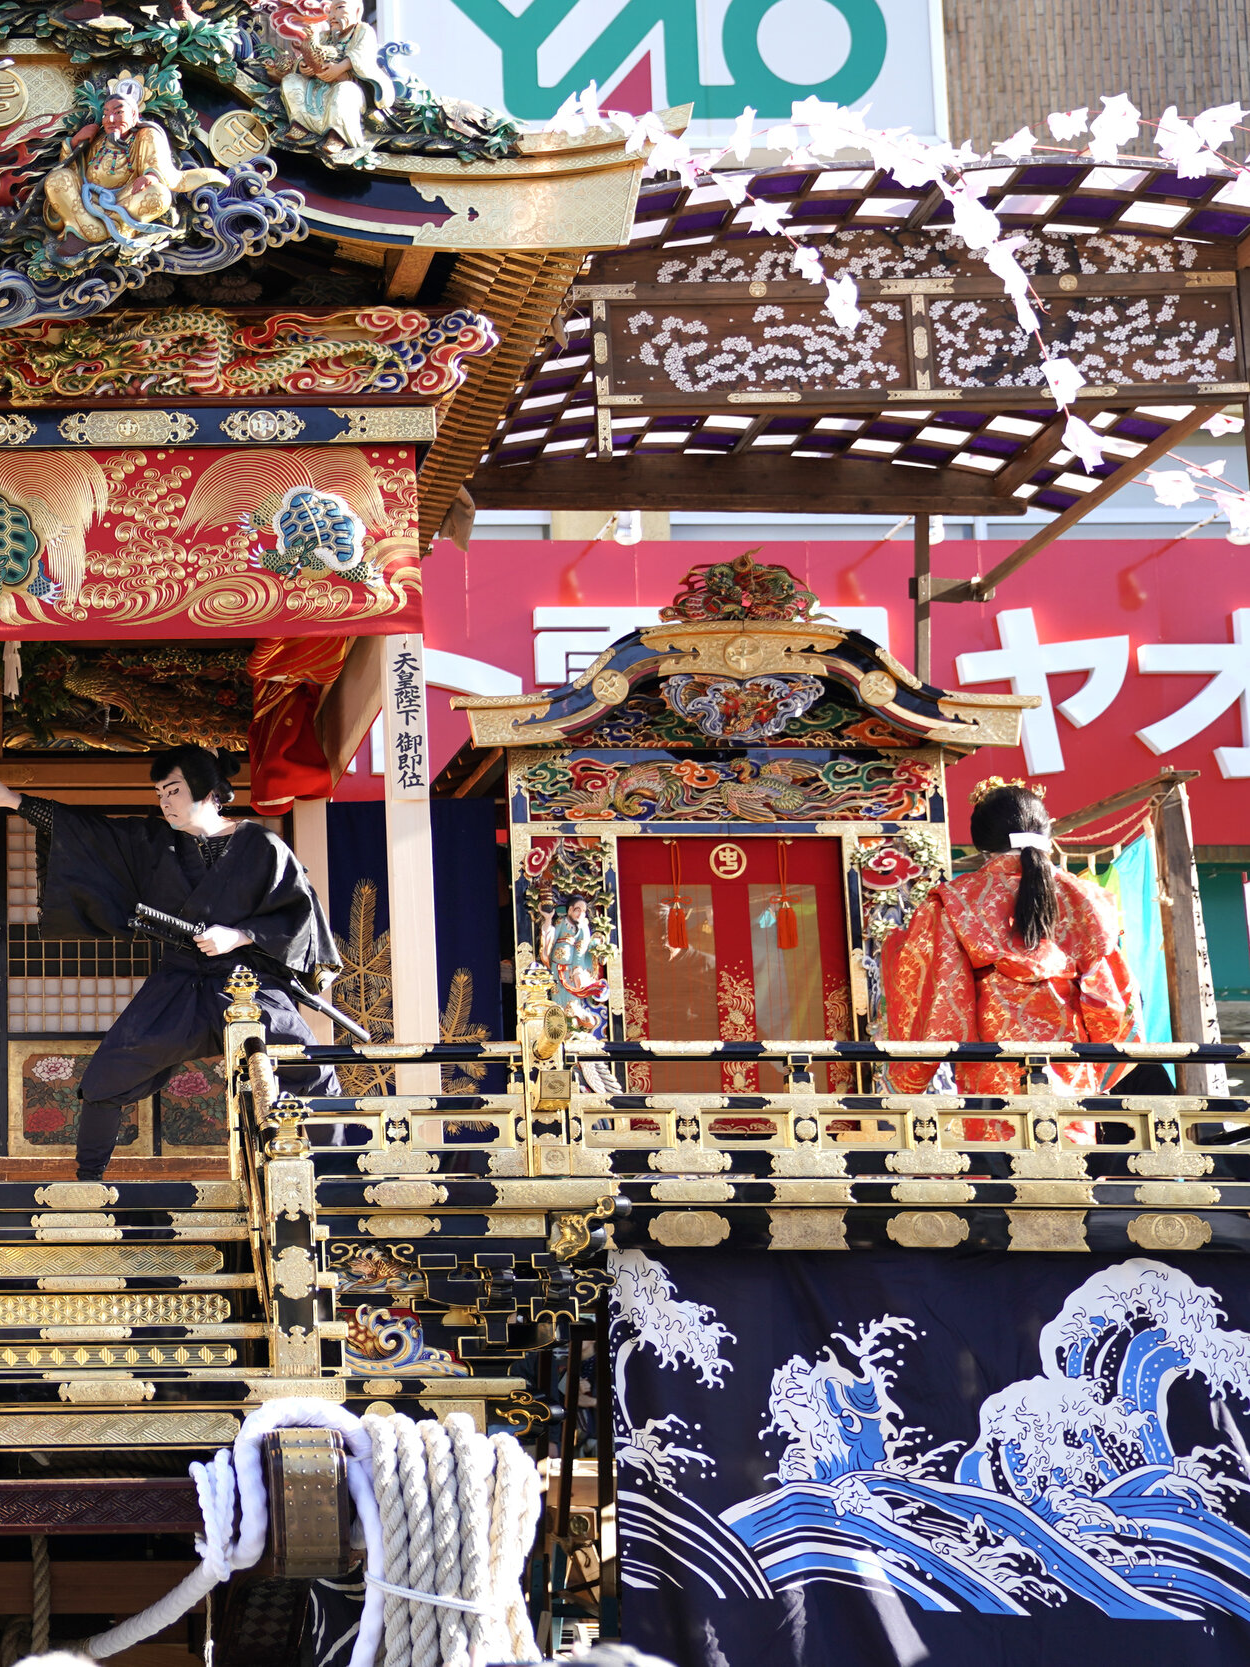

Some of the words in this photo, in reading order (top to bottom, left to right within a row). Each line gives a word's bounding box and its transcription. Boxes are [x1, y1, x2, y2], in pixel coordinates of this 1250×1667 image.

[393, 652, 421, 726] 天皇陛下
[395, 732, 425, 790] 御即位
